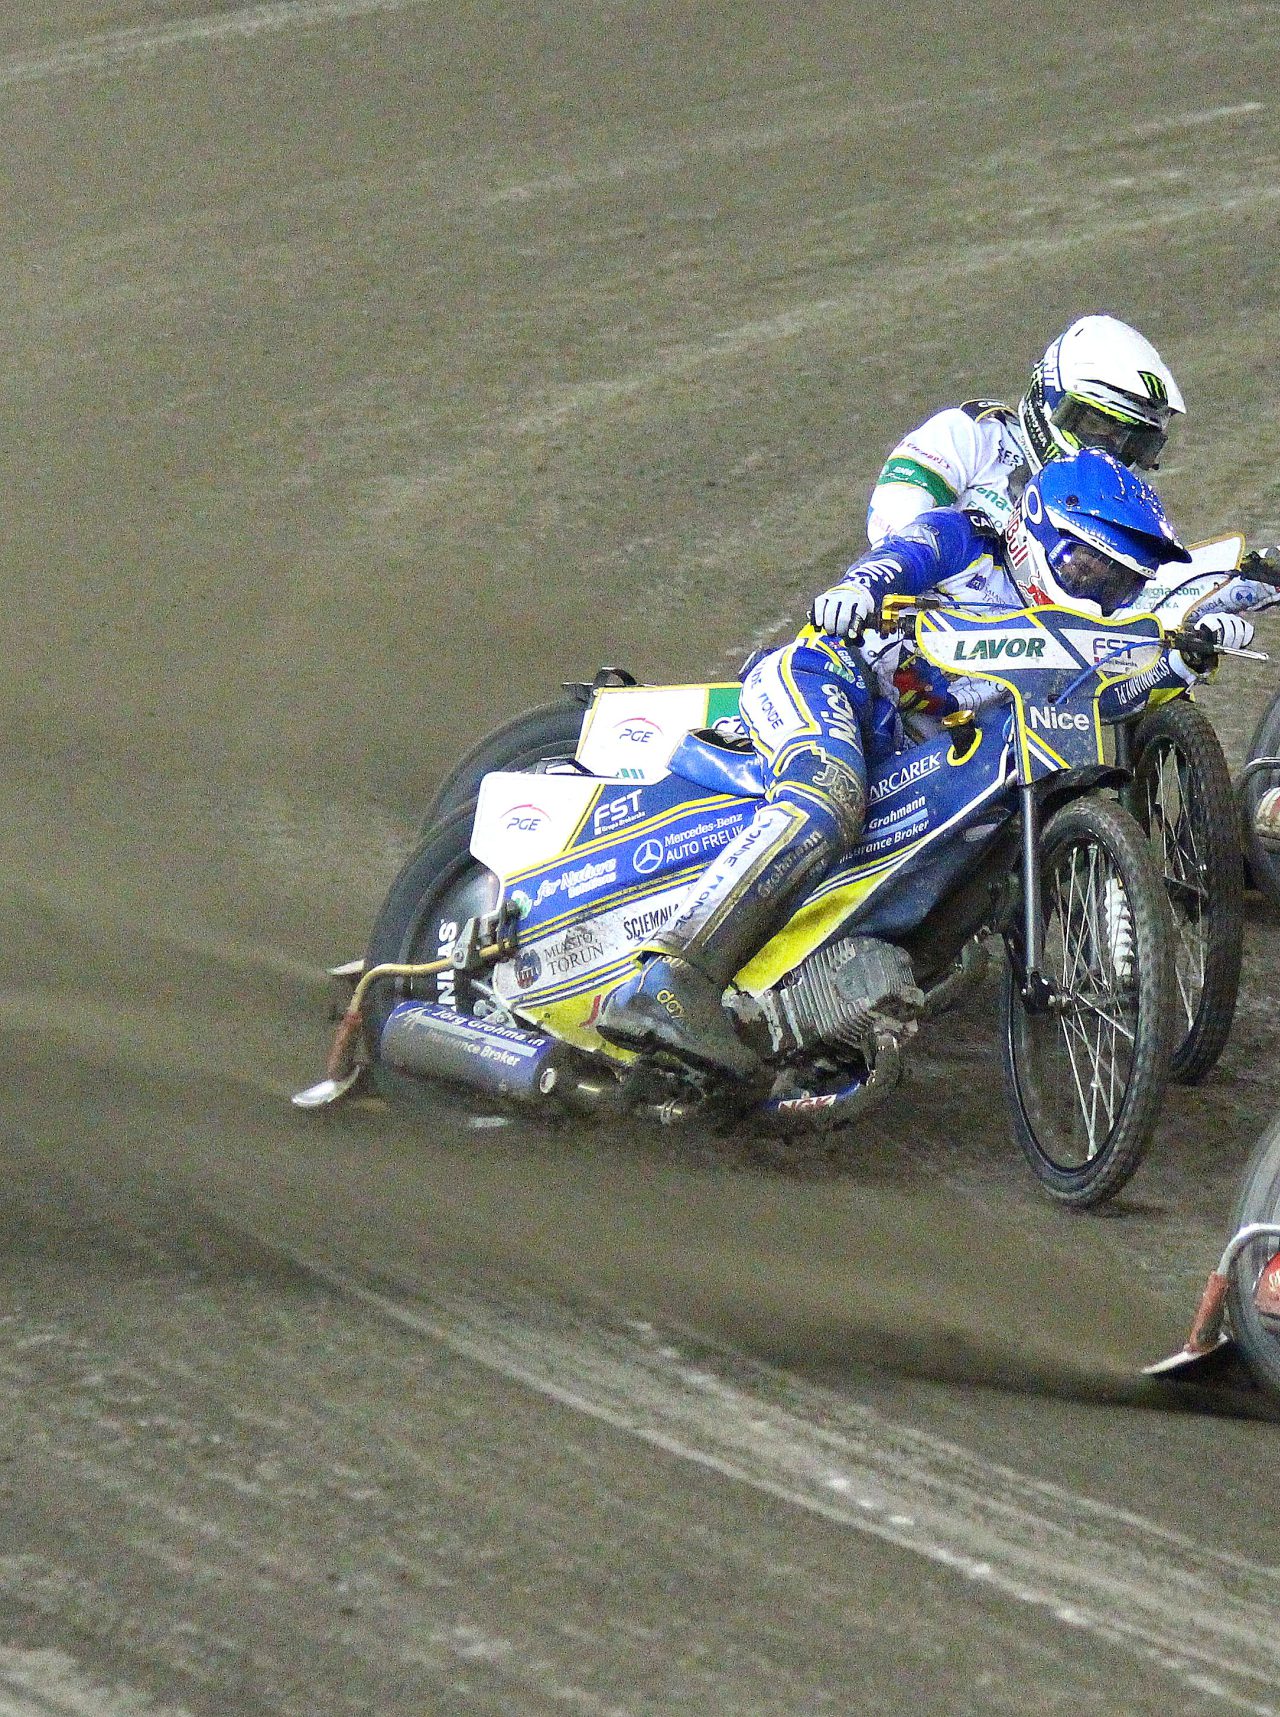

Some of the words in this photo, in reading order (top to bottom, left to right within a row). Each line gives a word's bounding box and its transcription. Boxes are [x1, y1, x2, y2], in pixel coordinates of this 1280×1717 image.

[953, 637, 1046, 661] LAVOR
[1029, 706, 1090, 731] Nice
[618, 728, 654, 743] PGE
[868, 751, 941, 801] ARCAREK
[593, 788, 643, 828] FST
[868, 795, 926, 830] Grohmann
[506, 816, 541, 832] PGE
[664, 812, 743, 848] Mercedes-Benz
[893, 818, 930, 844] Broker
[665, 839, 699, 864] AUTO
[543, 930, 594, 958] MIASTO
